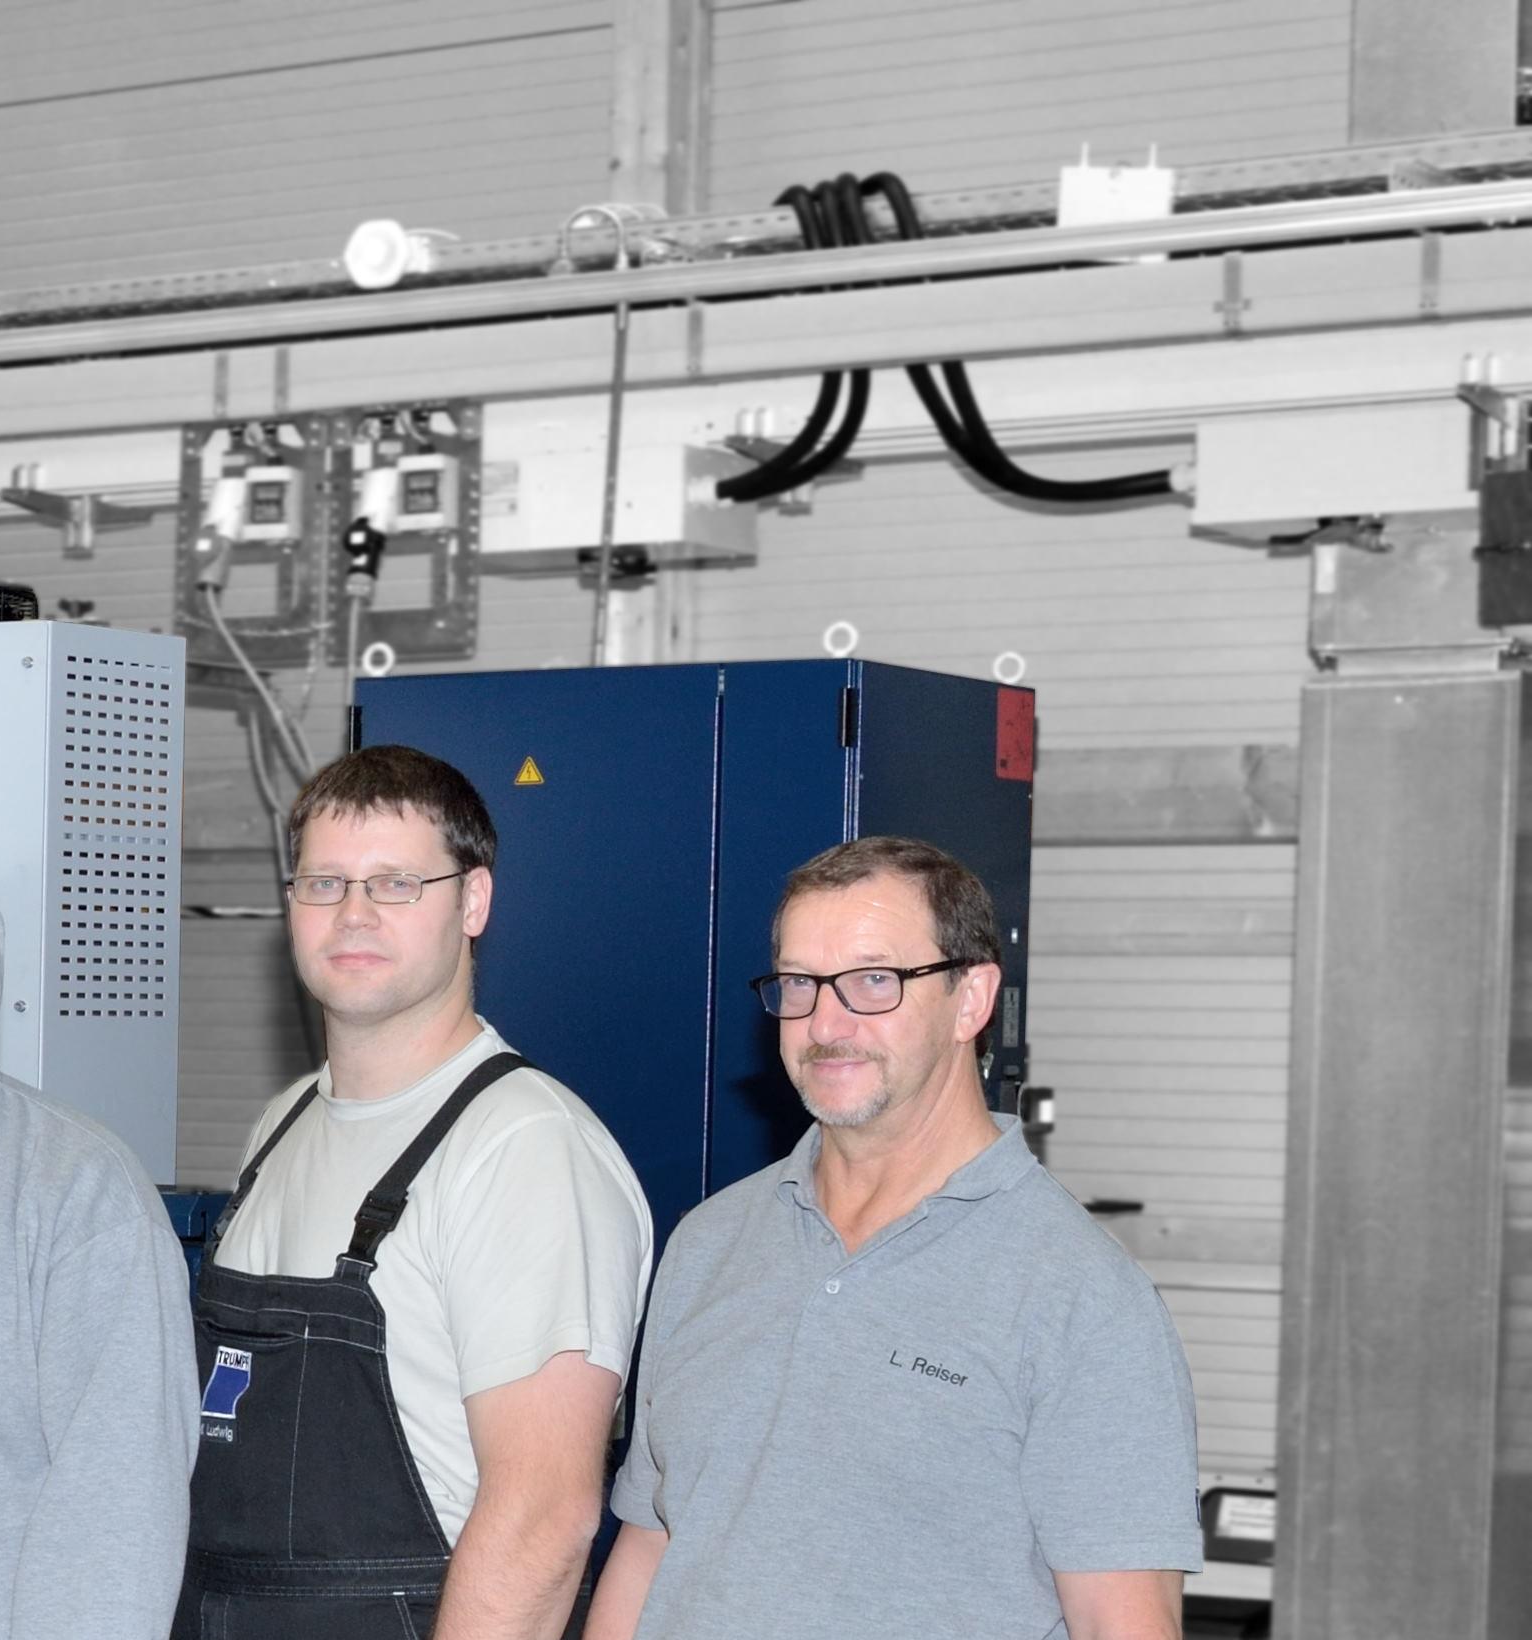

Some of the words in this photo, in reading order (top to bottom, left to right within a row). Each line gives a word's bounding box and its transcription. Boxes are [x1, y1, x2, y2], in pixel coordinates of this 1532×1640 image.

[218, 1350, 250, 1370] TRUMPF
[889, 1349, 903, 1368] L.
[911, 1356, 969, 1387] Reiser
